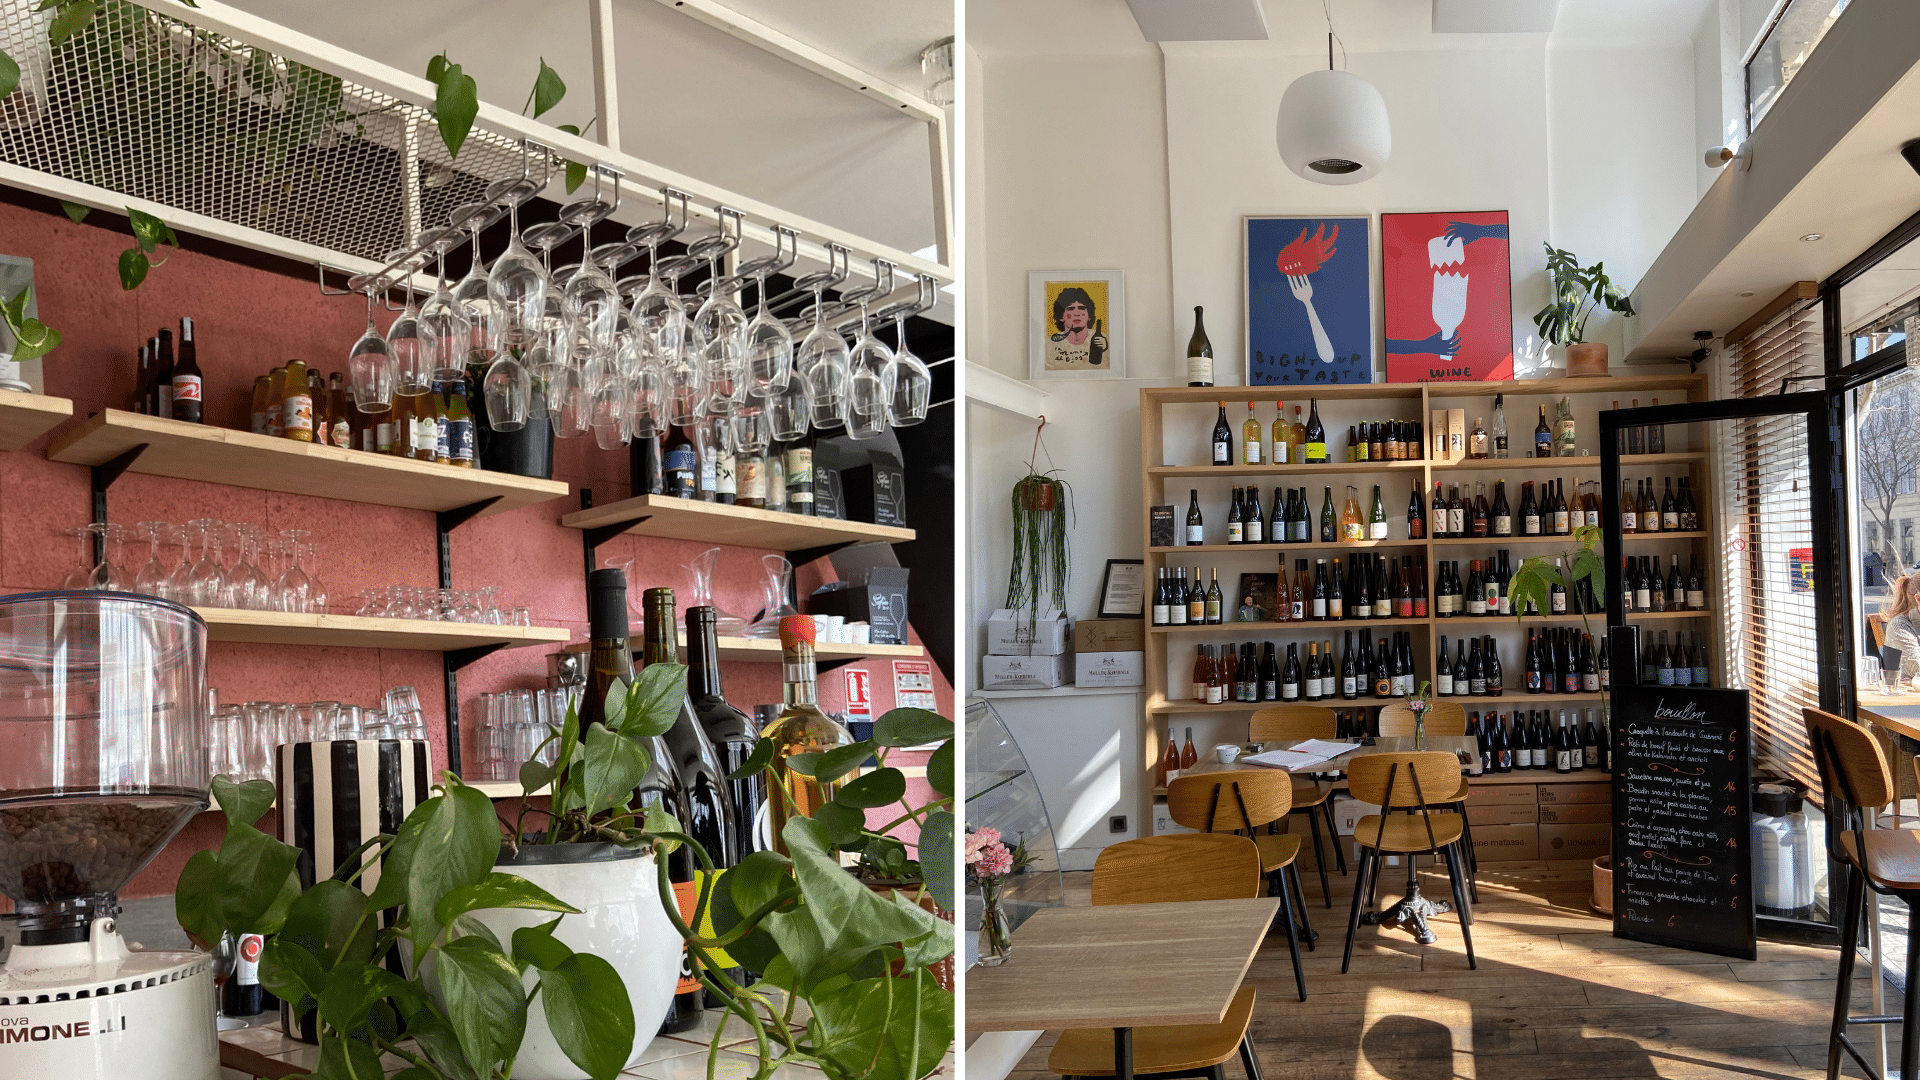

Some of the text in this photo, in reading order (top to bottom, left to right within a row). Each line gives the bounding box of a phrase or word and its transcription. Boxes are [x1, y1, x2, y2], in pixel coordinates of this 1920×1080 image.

[1338, 354, 1361, 365] UP
[1255, 369, 1365, 383] YOUR TASTE
[1430, 367, 1472, 378] WINE
[1654, 697, 1707, 723] bouillon
[1729, 730, 1737, 742] 6
[1684, 743, 1691, 752] et
[1728, 750, 1736, 762] 6
[1694, 778, 1701, 786] et
[1724, 781, 1736, 793] 14
[1627, 783, 1650, 794] Boudin
[1679, 790, 1686, 798] la
[1644, 805, 1650, 813] et
[1724, 805, 1737, 816] 15
[1698, 839, 1705, 847] et
[1726, 837, 1737, 848] 14
[1626, 857, 1637, 871] Riz
[1651, 860, 1662, 871] lait
[1694, 870, 1700, 878] de
[1730, 873, 1738, 885] 6
[1731, 896, 1738, 908] 6
[1668, 915, 1674, 927] 6
